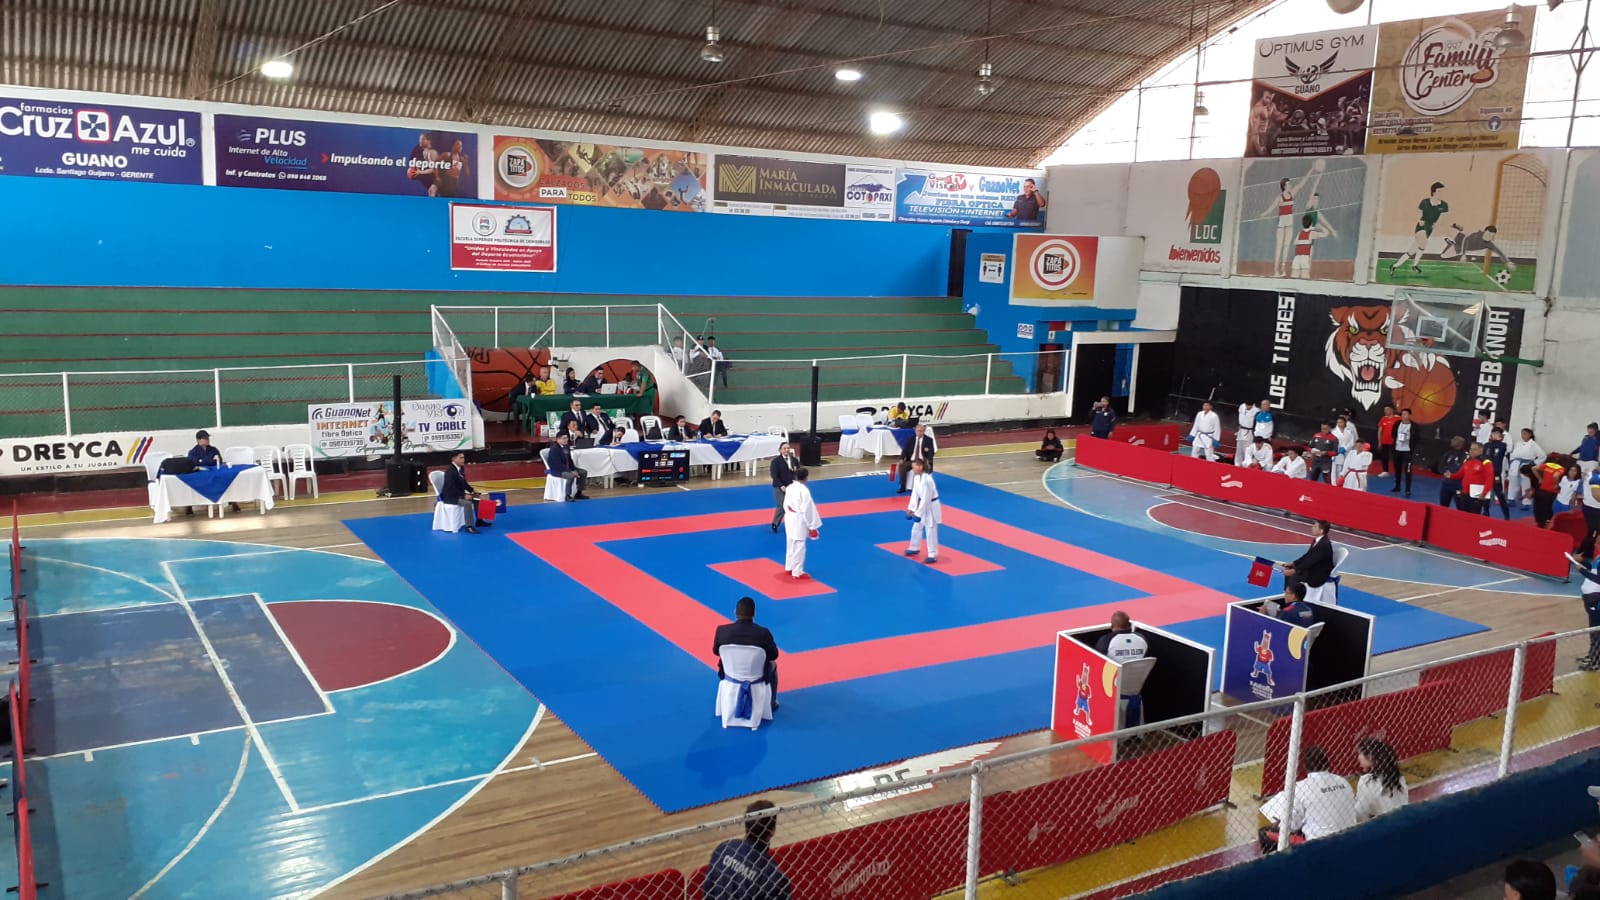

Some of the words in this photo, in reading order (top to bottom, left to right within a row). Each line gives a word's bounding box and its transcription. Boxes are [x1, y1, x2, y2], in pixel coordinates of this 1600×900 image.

[1259, 39, 1324, 57] OPTIMUS
[1330, 34, 1364, 49] GYM
[1422, 42, 1495, 71] Family
[1295, 84, 1320, 94] GUANO
[1416, 69, 1470, 98] Center
[20, 102, 73, 115] farmacias
[0, 106, 73, 139] Cruz
[112, 115, 185, 146] Azul
[254, 127, 306, 146] PLUS
[131, 146, 150, 155] me
[153, 146, 186, 157] cuida
[228, 146, 259, 155] Internet
[260, 148, 271, 156] de
[271, 149, 288, 157] Alta
[61, 152, 128, 168] GUANO
[264, 156, 307, 166] Velocidad
[330, 153, 394, 167] Impulsando
[395, 157, 406, 167] el
[408, 158, 451, 170] deporte
[760, 168, 798, 180] MARÍA
[760, 179, 837, 194] INMACULADA
[569, 194, 597, 202] TODOS
[1194, 225, 1218, 240] LDC
[1168, 244, 1222, 263] bienvenidos
[1272, 295, 1297, 365] TIGRES
[1268, 374, 1289, 410] LOS
[325, 406, 371, 419] GuanoNet
[316, 420, 369, 430] INTERNET
[418, 422, 430, 433] TV
[436, 420, 467, 432] CABLE
[13, 440, 123, 462] DREYCA
